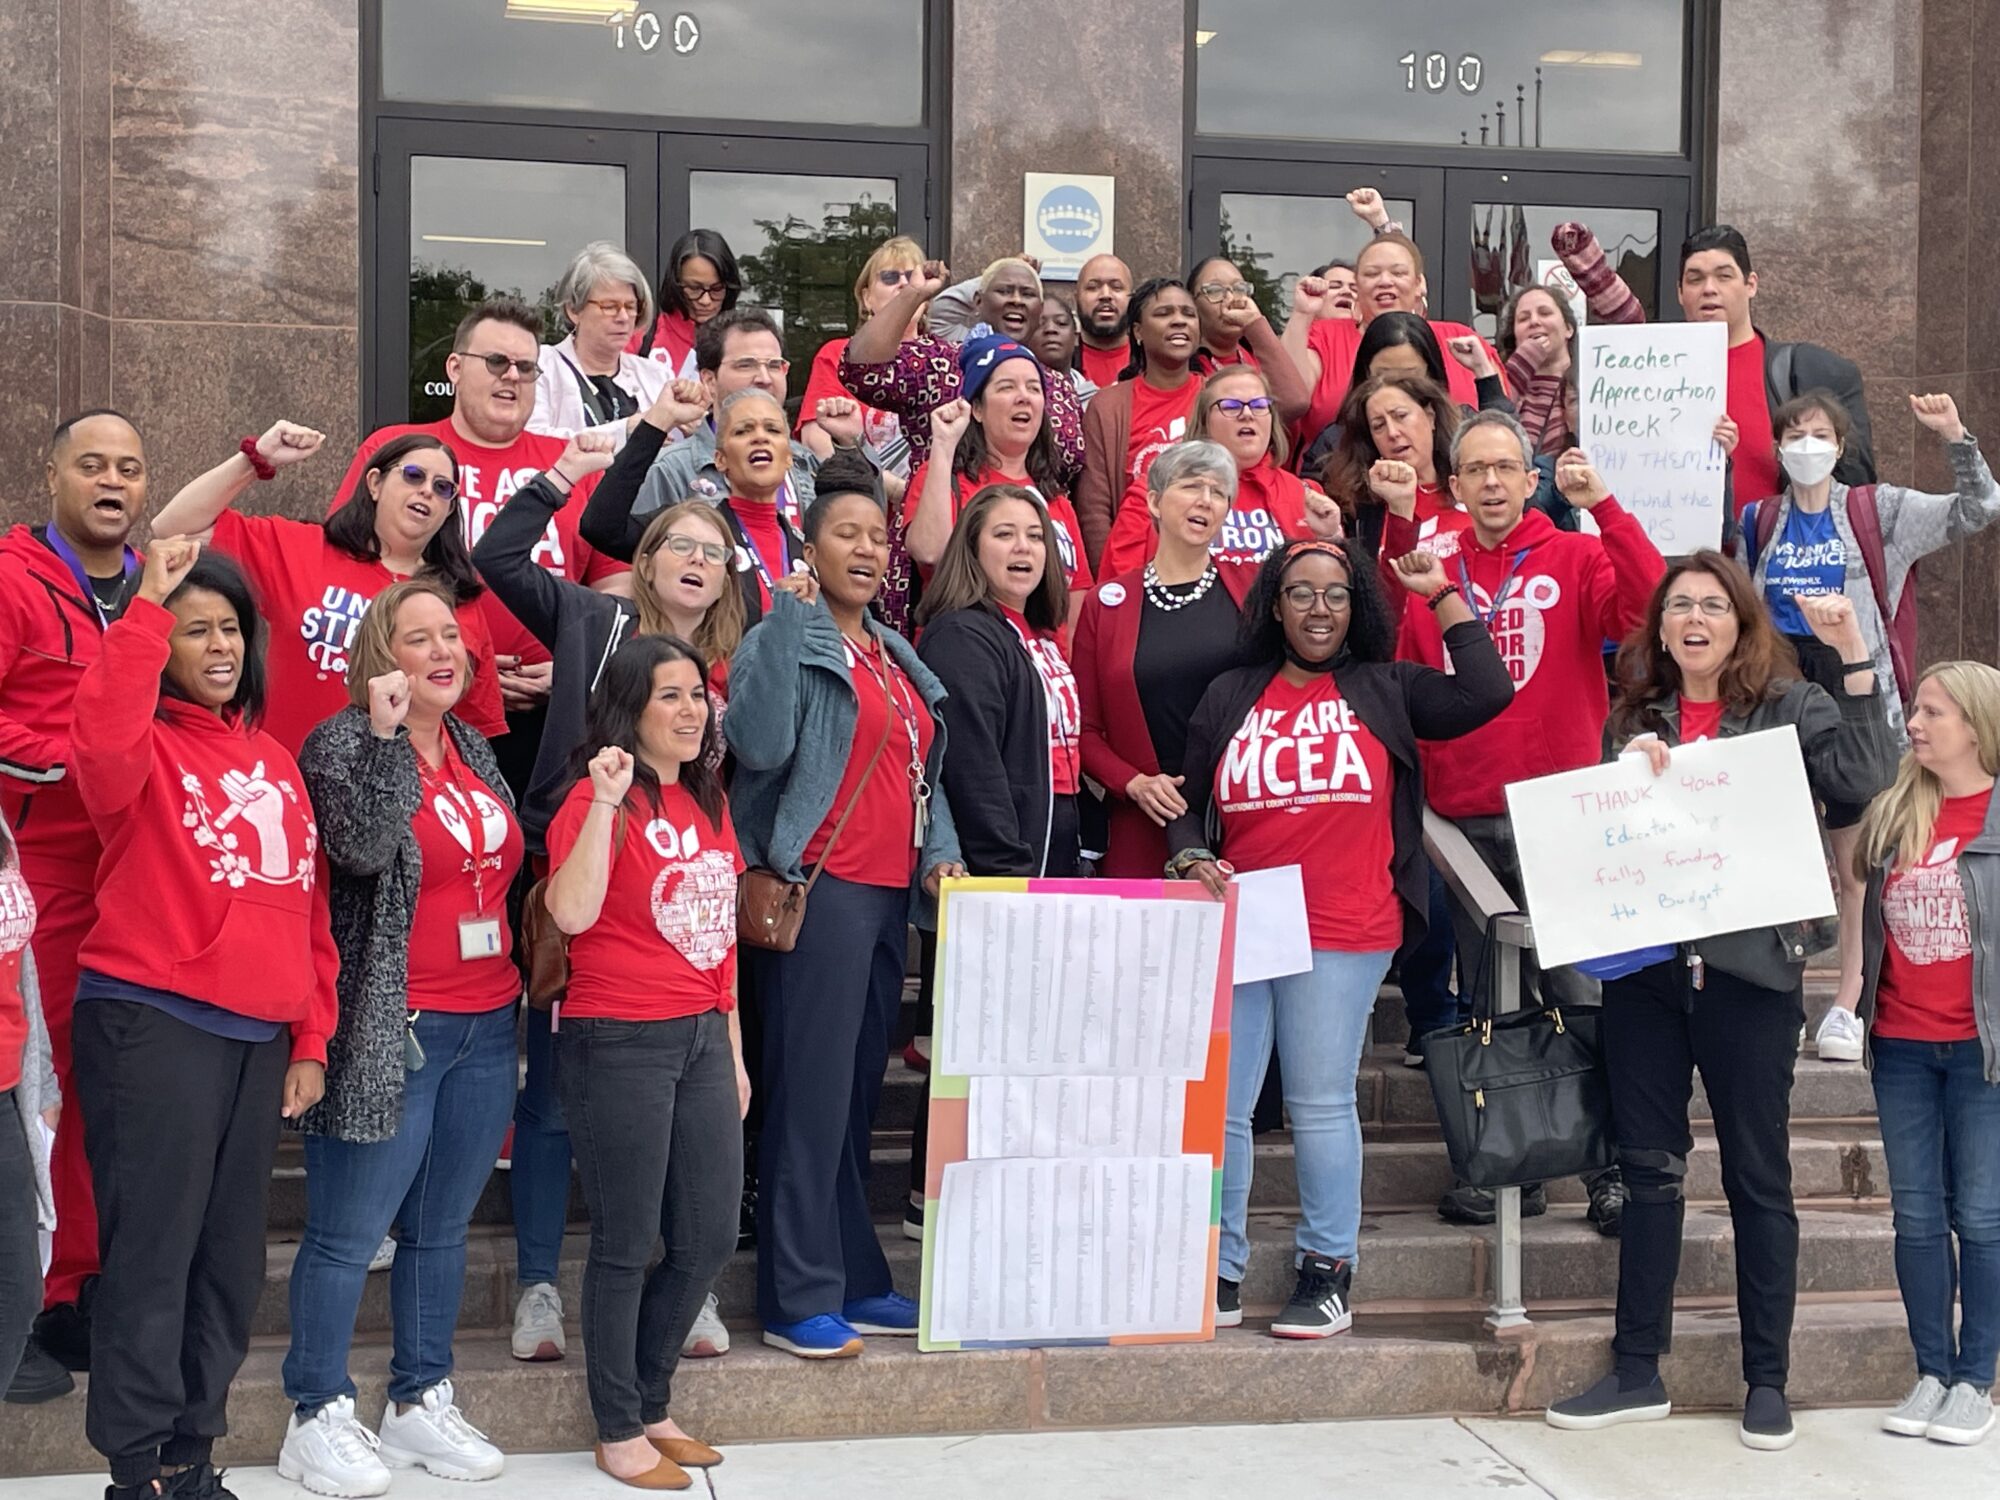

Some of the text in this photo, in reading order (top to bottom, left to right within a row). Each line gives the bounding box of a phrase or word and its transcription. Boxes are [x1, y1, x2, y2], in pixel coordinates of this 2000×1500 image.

[607, 11, 699, 53] 100
[1400, 53, 1481, 91] 100
[1592, 344, 1688, 371] Teacher
[424, 381, 456, 396] COU
[1589, 377, 1716, 409] Appreciation
[1591, 444, 1628, 471] PAY
[1681, 490, 1713, 508] the
[1648, 518, 1676, 541] PS
[322, 585, 372, 619] UN
[301, 607, 361, 650] ST
[1495, 633, 1525, 657] OR
[1508, 659, 1525, 682] D
[1235, 698, 1360, 742] WE ARE
[1220, 733, 1373, 801] MCEA
[1571, 785, 1654, 816] THANK
[461, 854, 503, 873] Song
[1663, 848, 1731, 871] funding
[1916, 874, 1962, 891] ORGANIZ
[1658, 883, 1724, 911] Budget
[1906, 897, 1963, 929] MCEA
